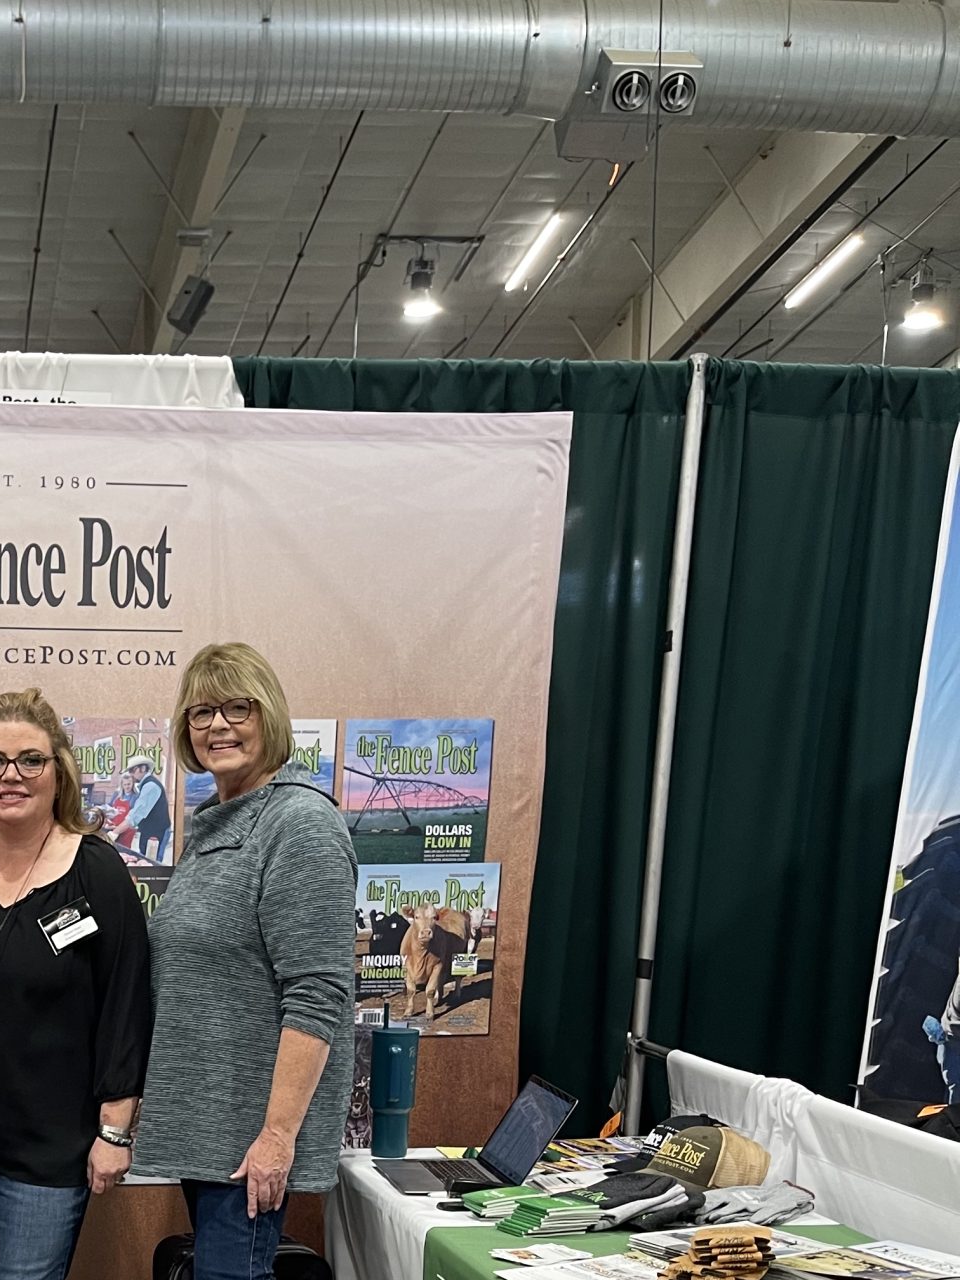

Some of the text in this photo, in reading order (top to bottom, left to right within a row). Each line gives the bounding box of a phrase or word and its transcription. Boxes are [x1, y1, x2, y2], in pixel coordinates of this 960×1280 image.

[39, 475, 98, 490] 1980
[77, 516, 172, 610] Post
[66, 734, 116, 776] ence
[290, 737, 321, 775] ost
[356, 734, 478, 775] the Fence Post
[424, 836, 472, 849] FLOW IN
[425, 824, 473, 836] DOLLARS
[366, 879, 385, 902] the
[445, 878, 486, 911] Post
[362, 954, 408, 968] INQUIRY
[360, 968, 407, 980] ONGOING
[676, 1142, 706, 1167] Post
